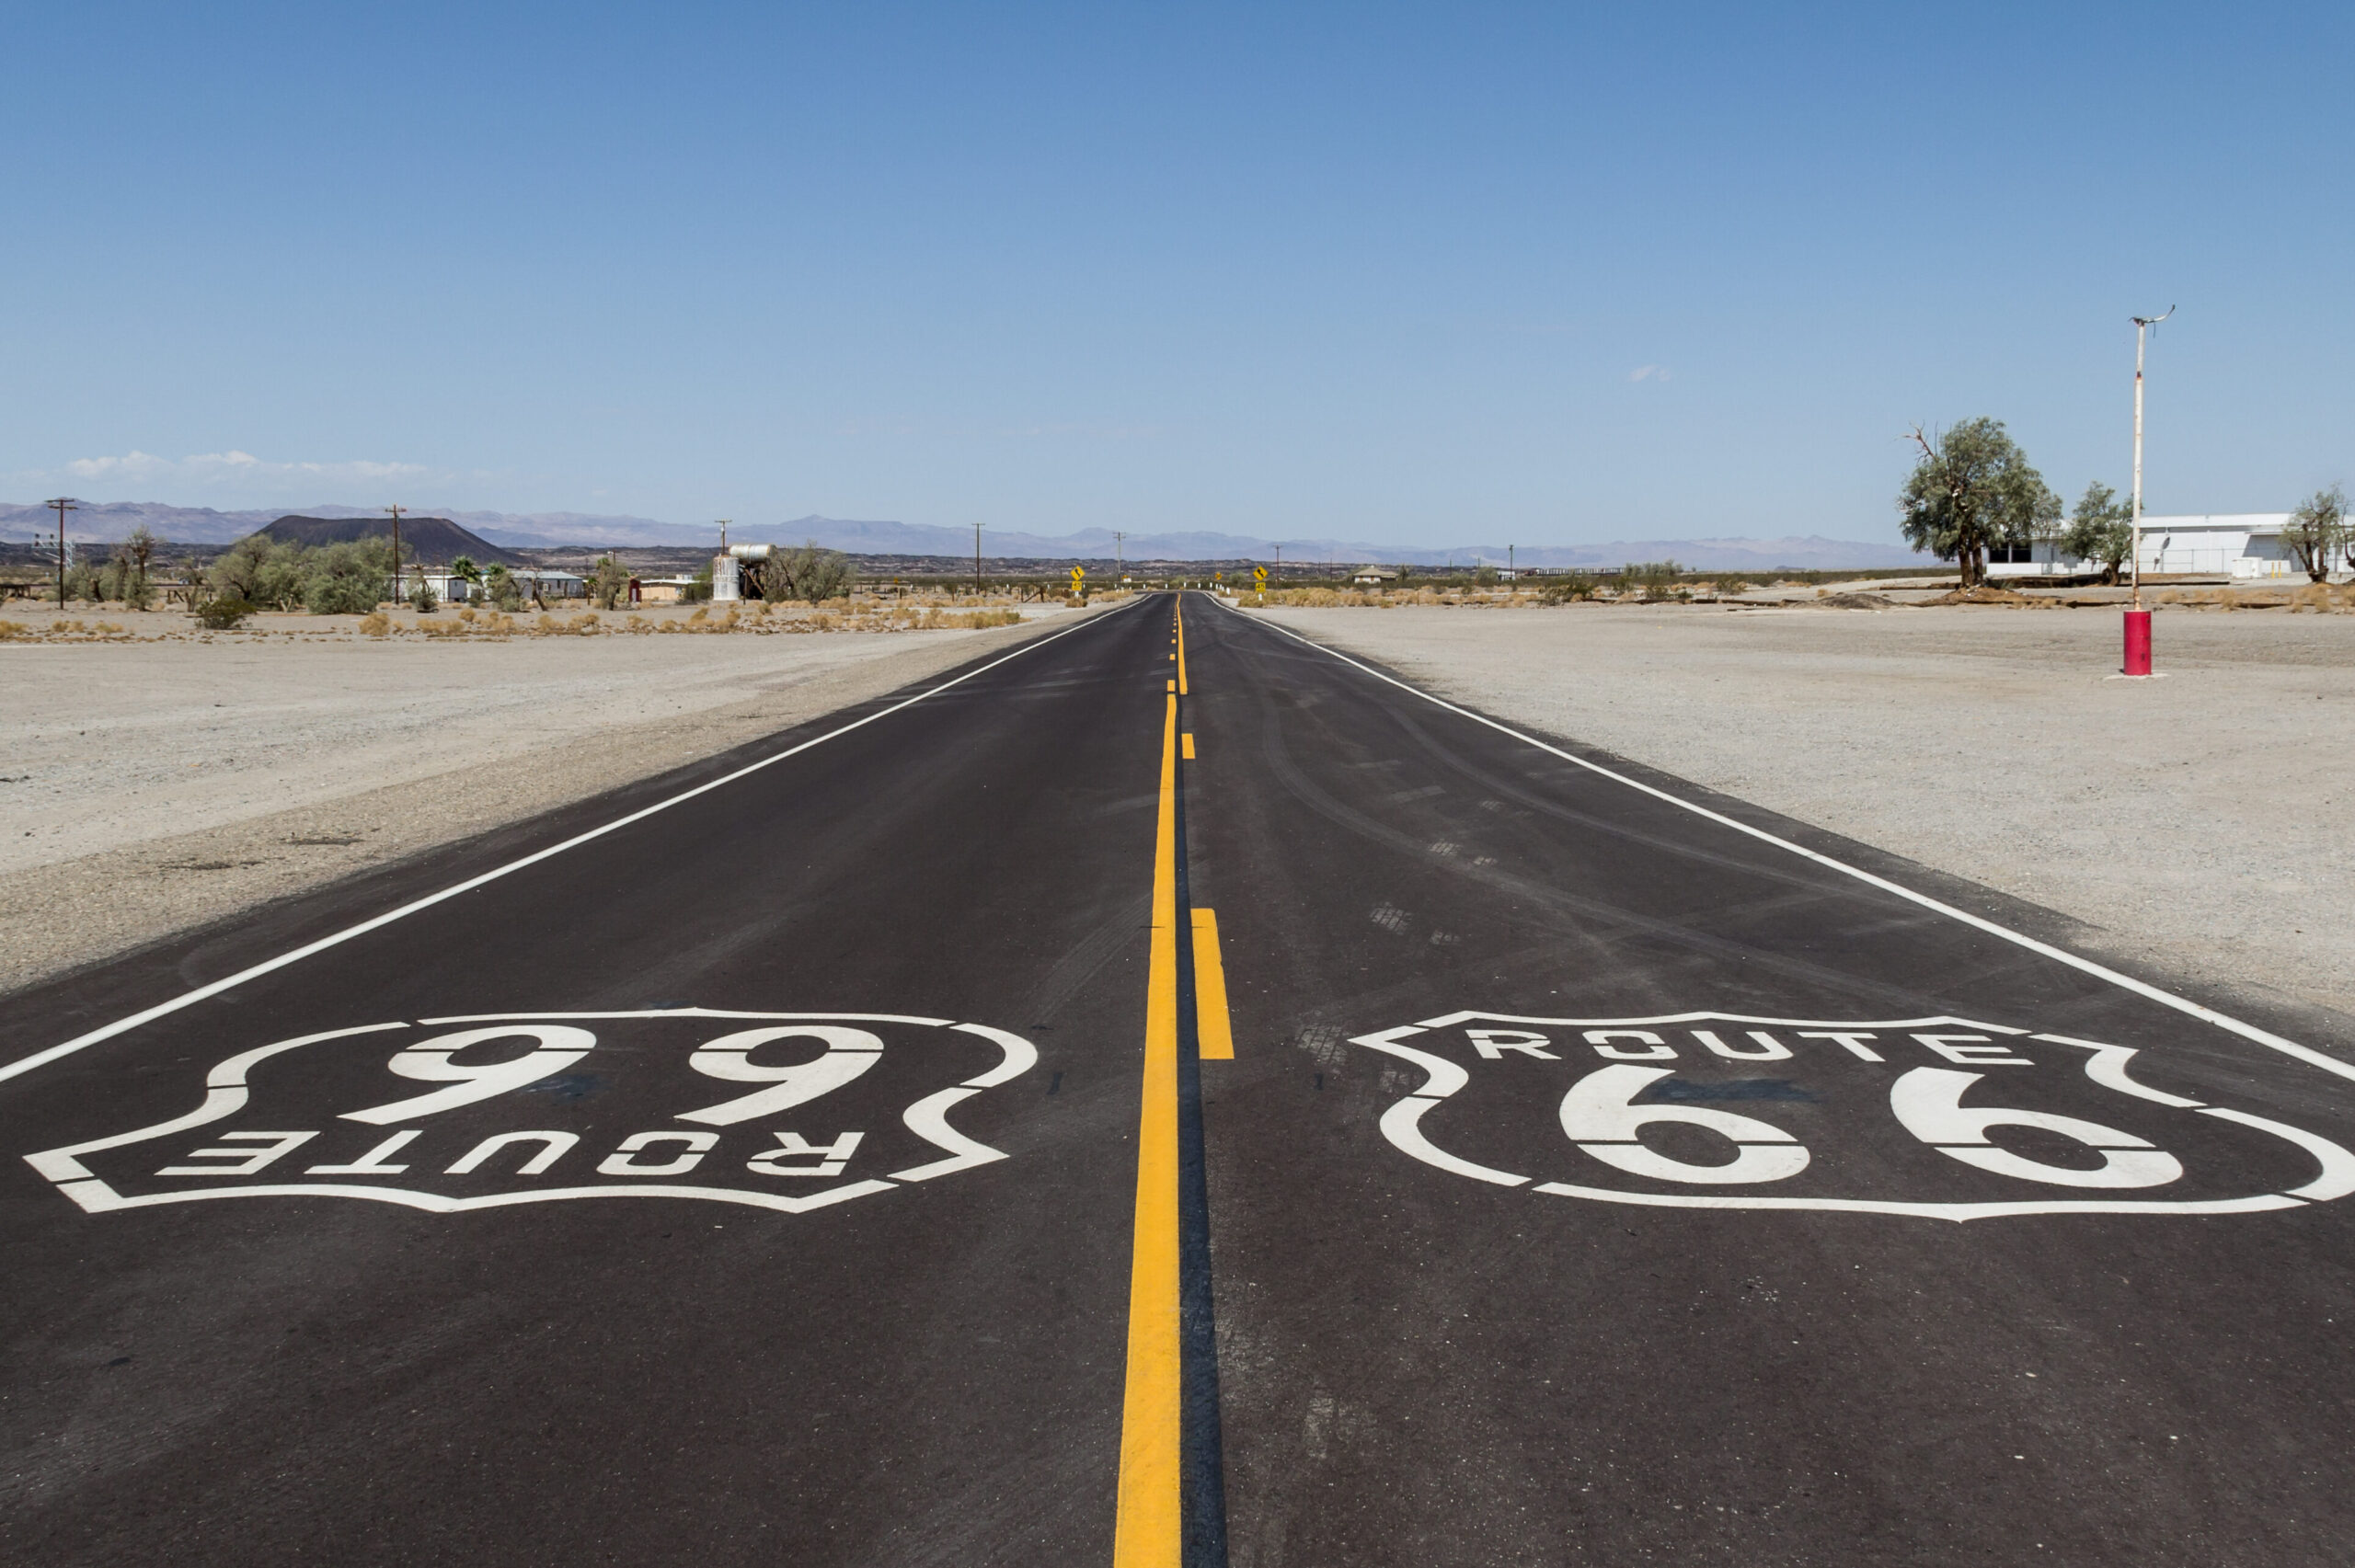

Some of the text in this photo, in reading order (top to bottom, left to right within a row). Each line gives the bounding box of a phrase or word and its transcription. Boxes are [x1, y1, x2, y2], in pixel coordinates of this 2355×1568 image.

[1465, 1030, 2034, 1065] ROUTE
[1559, 1064, 2183, 1188] 66
[155, 1131, 865, 1175] ROUTE
